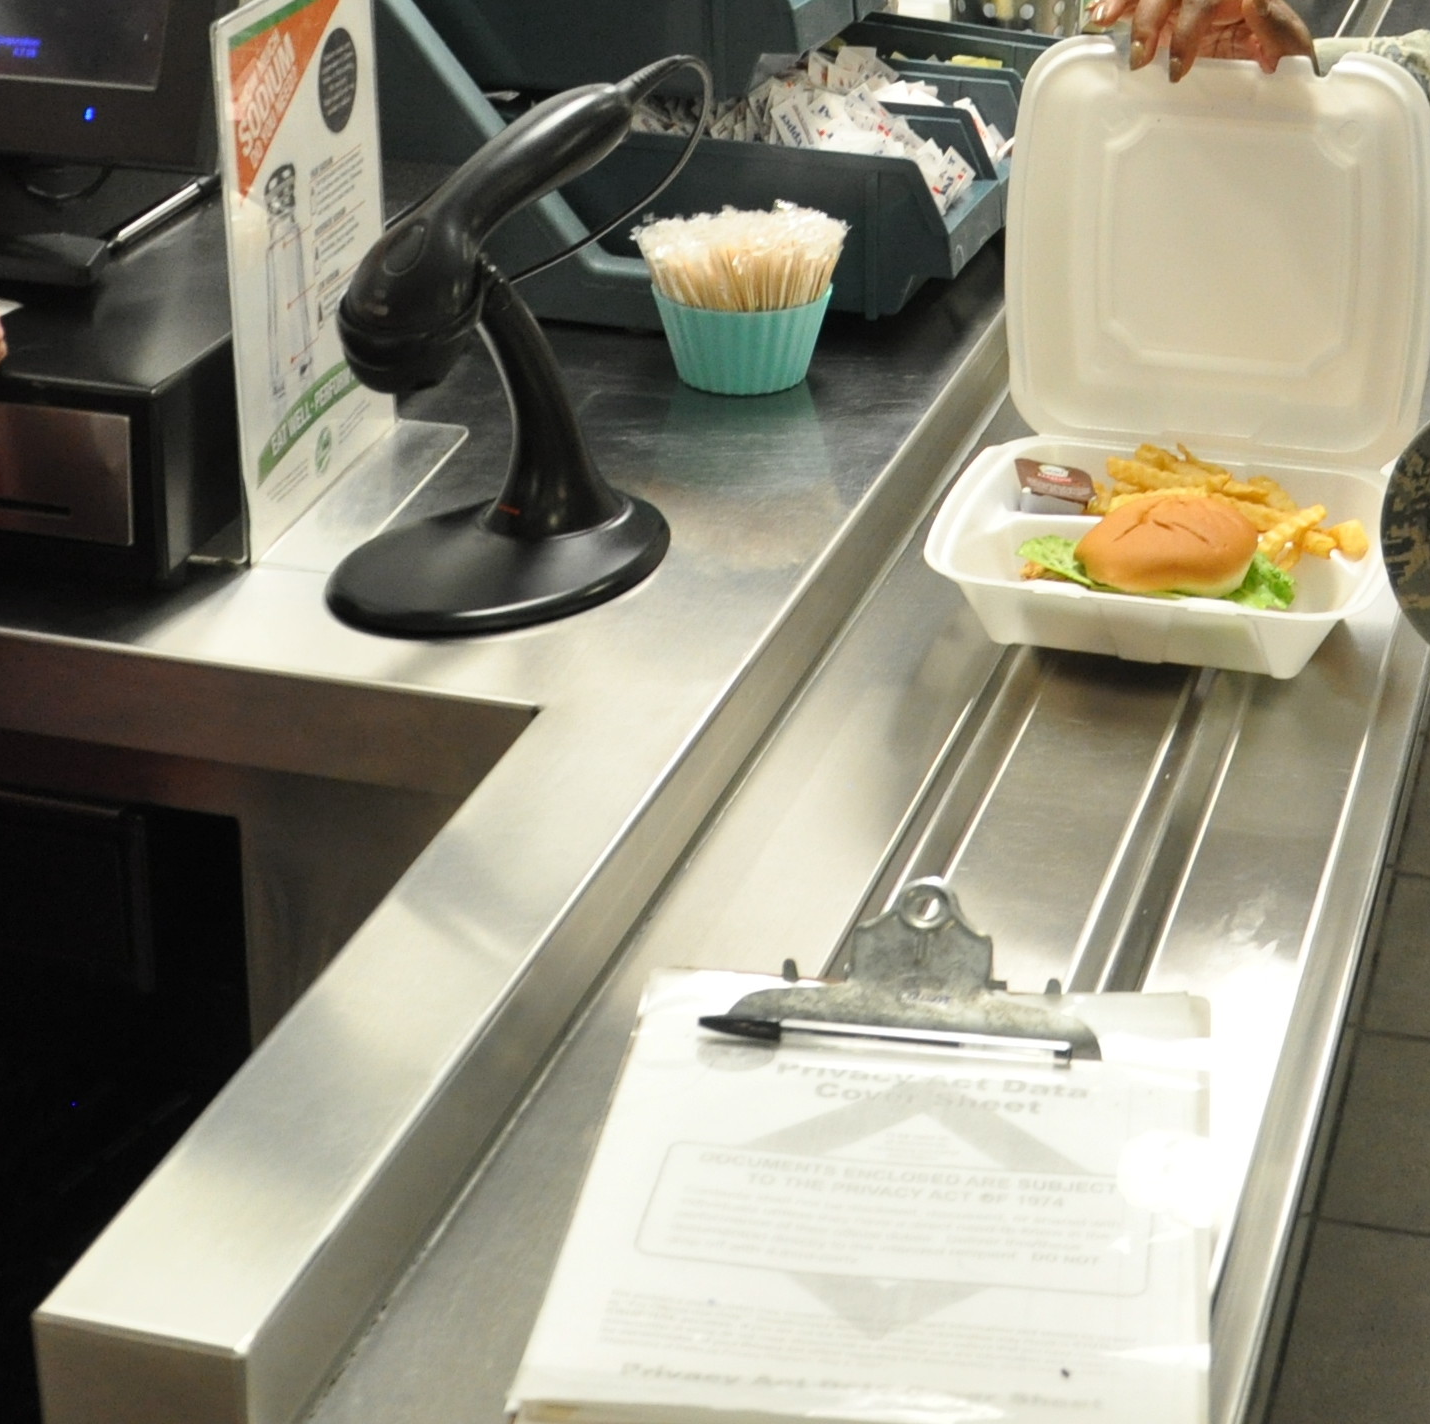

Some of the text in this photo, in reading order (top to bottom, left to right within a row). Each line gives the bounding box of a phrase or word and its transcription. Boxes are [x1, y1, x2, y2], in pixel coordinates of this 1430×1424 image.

[238, 31, 296, 157] SODIUM
[272, 422, 288, 456] EAT
[287, 402, 312, 437] WELL
[776, 1063, 1089, 1100] Privacy Act Data
[815, 1083, 1041, 1115] Cover Sheet
[699, 1152, 1117, 1197] DOCUMENTS ENCLOSED ARE SUBJECT
[746, 1173, 1064, 1210] TO THE PRIVACY ACT OF 1974
[619, 1362, 740, 1387] Privacy
[1008, 1392, 1103, 1411] Sheet
